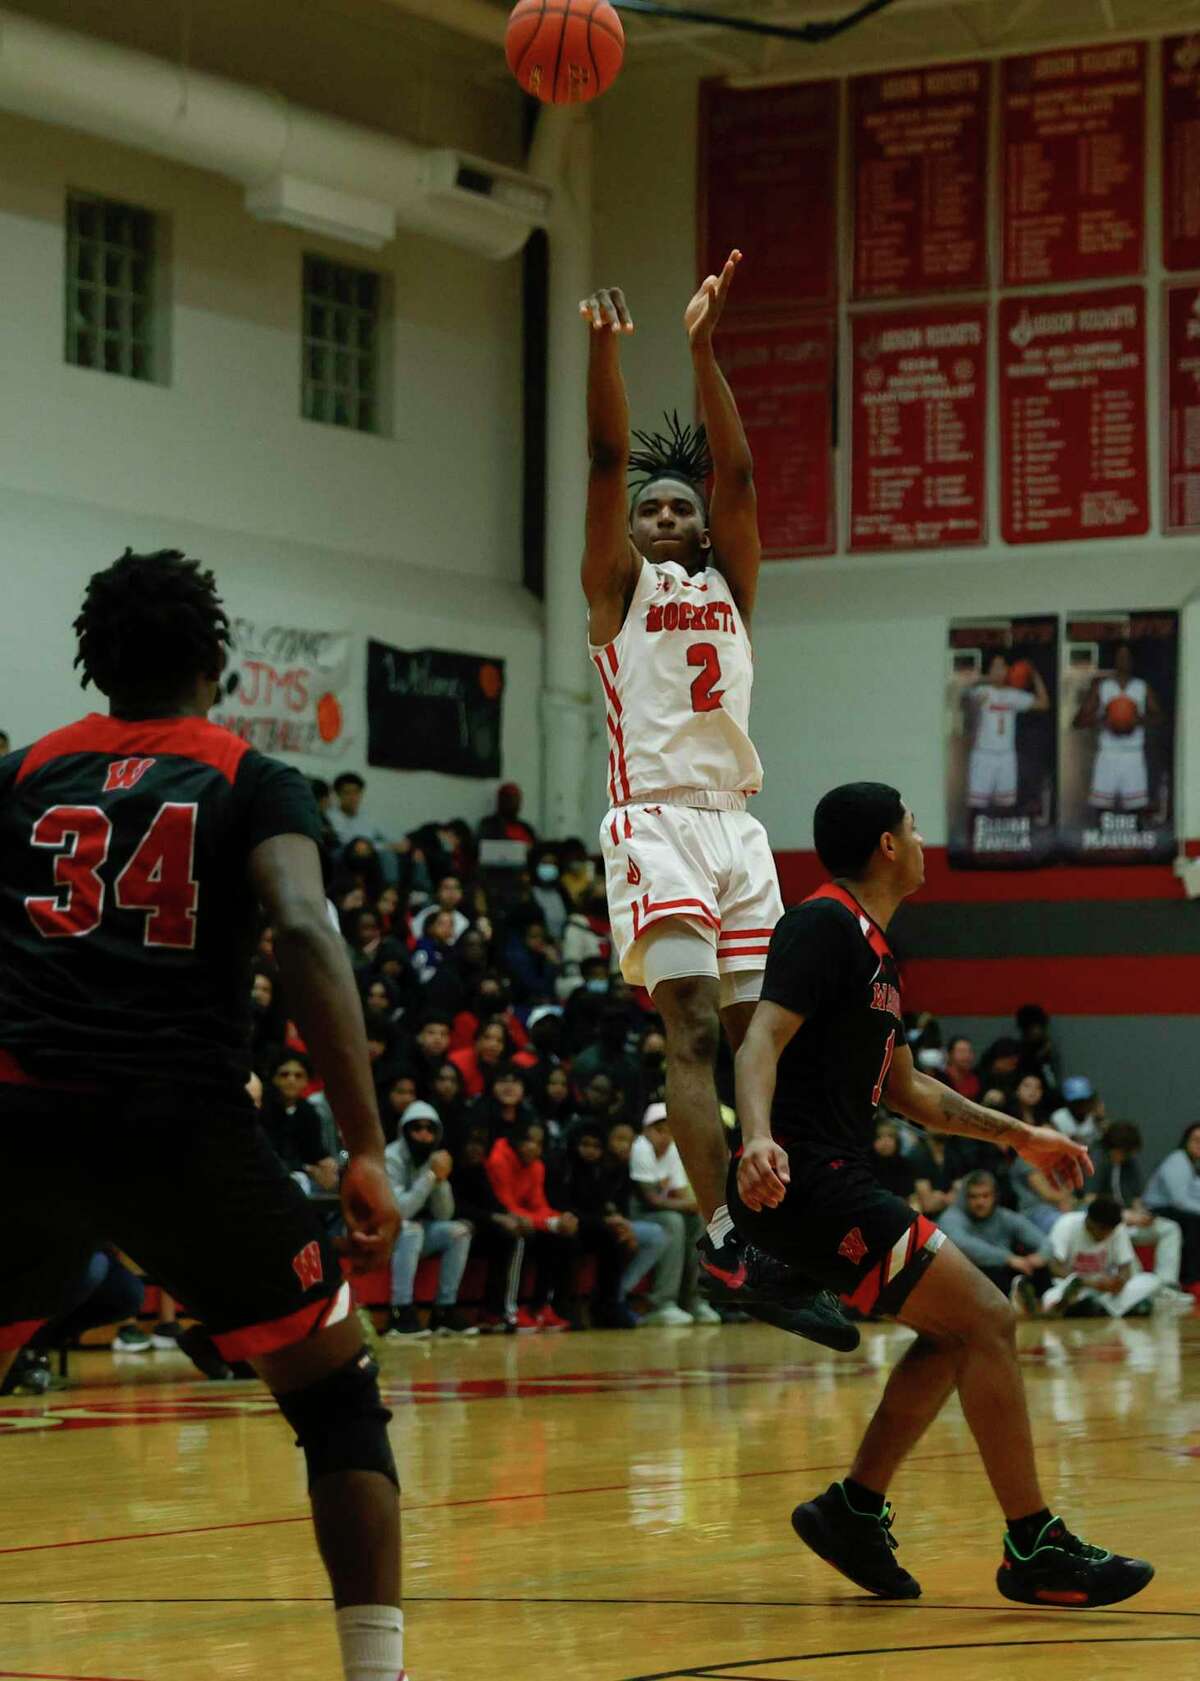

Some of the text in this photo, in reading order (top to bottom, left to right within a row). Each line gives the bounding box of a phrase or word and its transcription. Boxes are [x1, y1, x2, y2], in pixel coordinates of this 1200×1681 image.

[239, 660, 309, 712] JMS
[687, 643, 725, 712] 2
[102, 757, 156, 792] W
[25, 802, 199, 949] 34
[871, 1028, 896, 1107] 1
